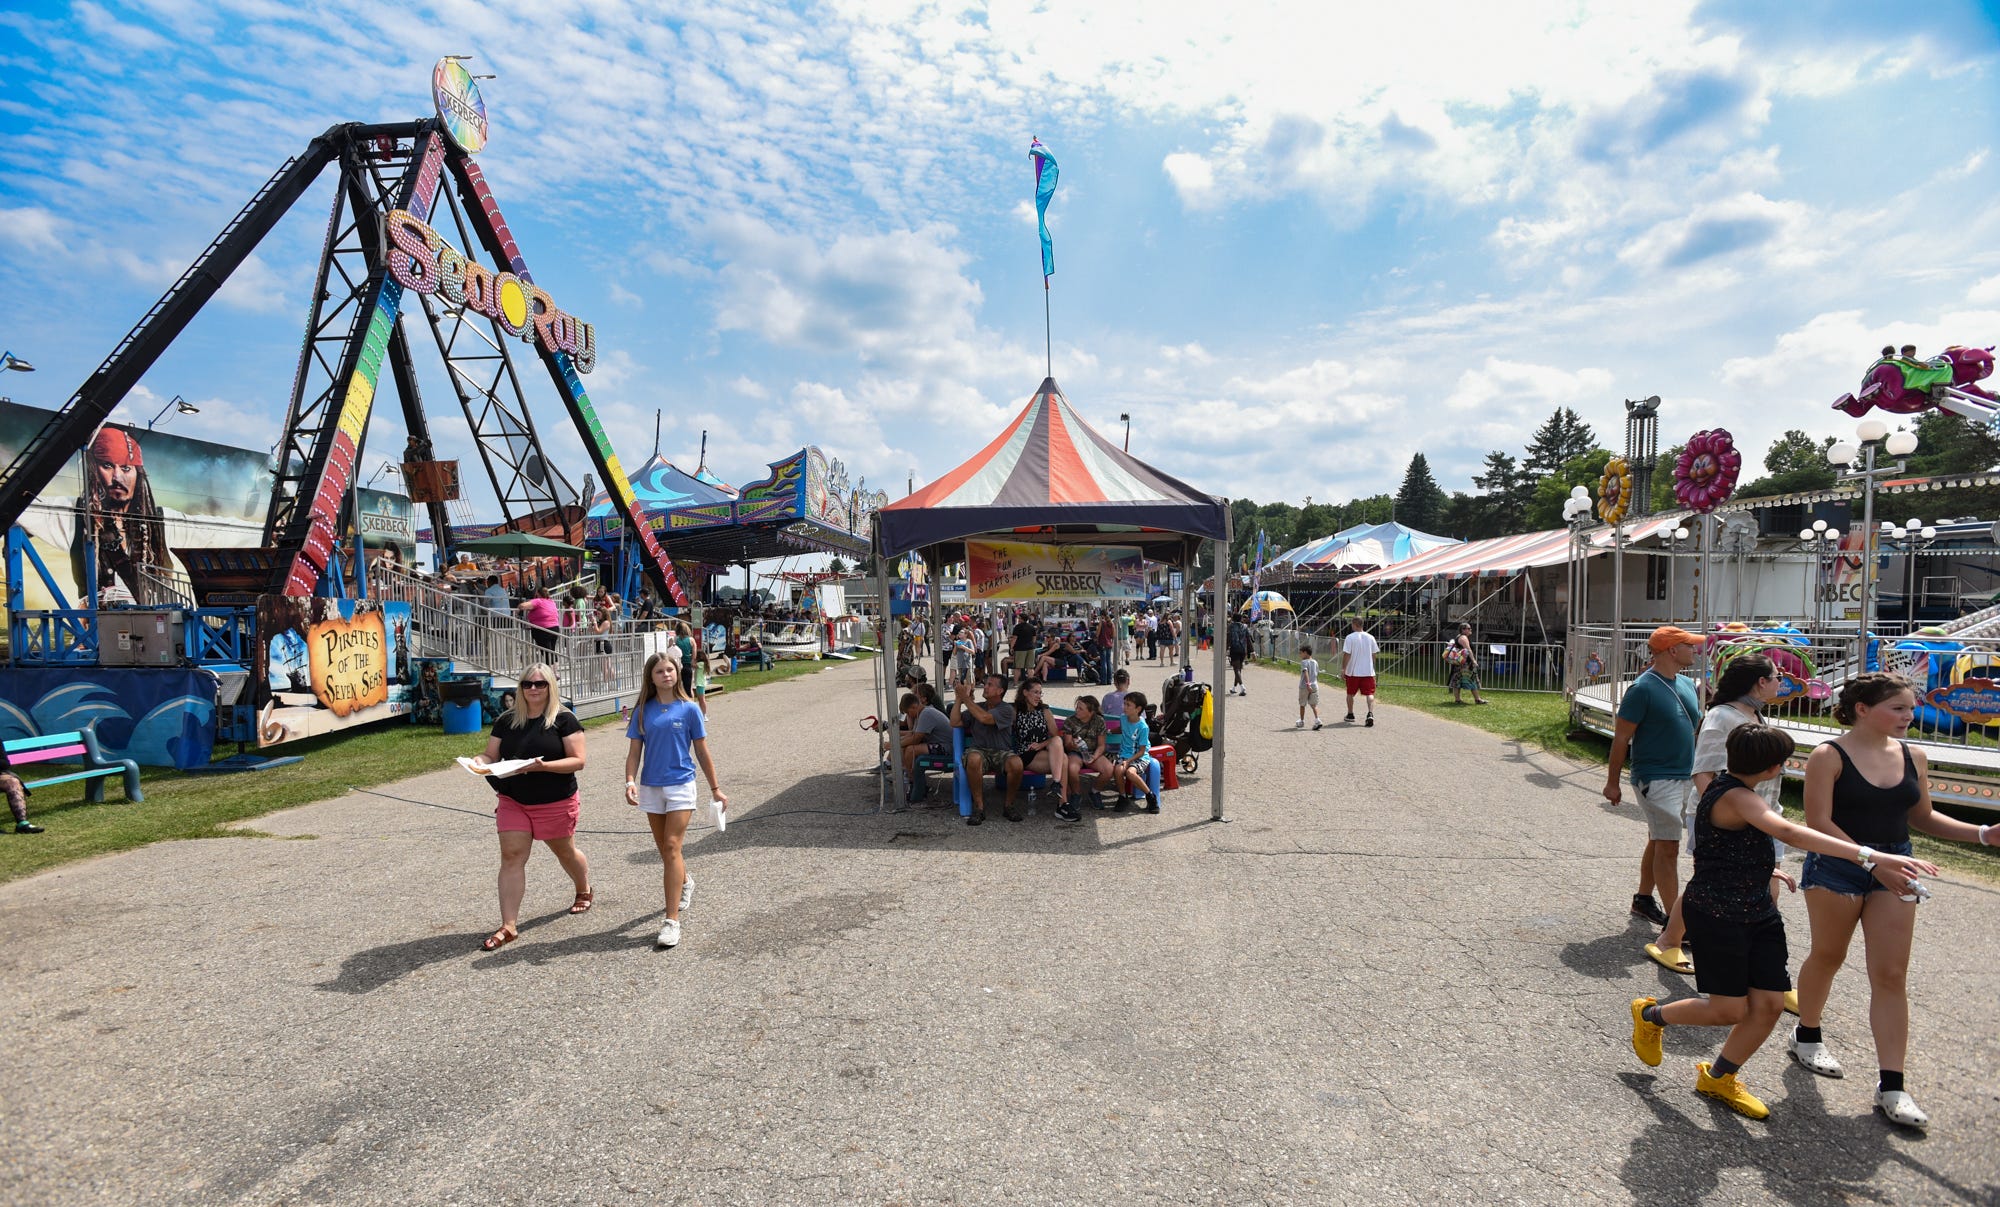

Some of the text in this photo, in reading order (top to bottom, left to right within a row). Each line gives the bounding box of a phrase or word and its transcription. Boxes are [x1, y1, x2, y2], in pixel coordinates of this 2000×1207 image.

[441, 91, 484, 134] SKERBECK
[362, 516, 410, 538] SKERBECK
[992, 547, 1008, 560] THE
[996, 559, 1012, 573] FUN
[978, 564, 1033, 593] STARTS HERE
[1035, 575, 1106, 595] SKERBECK
[320, 629, 379, 667] PIRATES
[338, 653, 372, 673] OF THE
[323, 670, 383, 704] SEVEN SEAS
